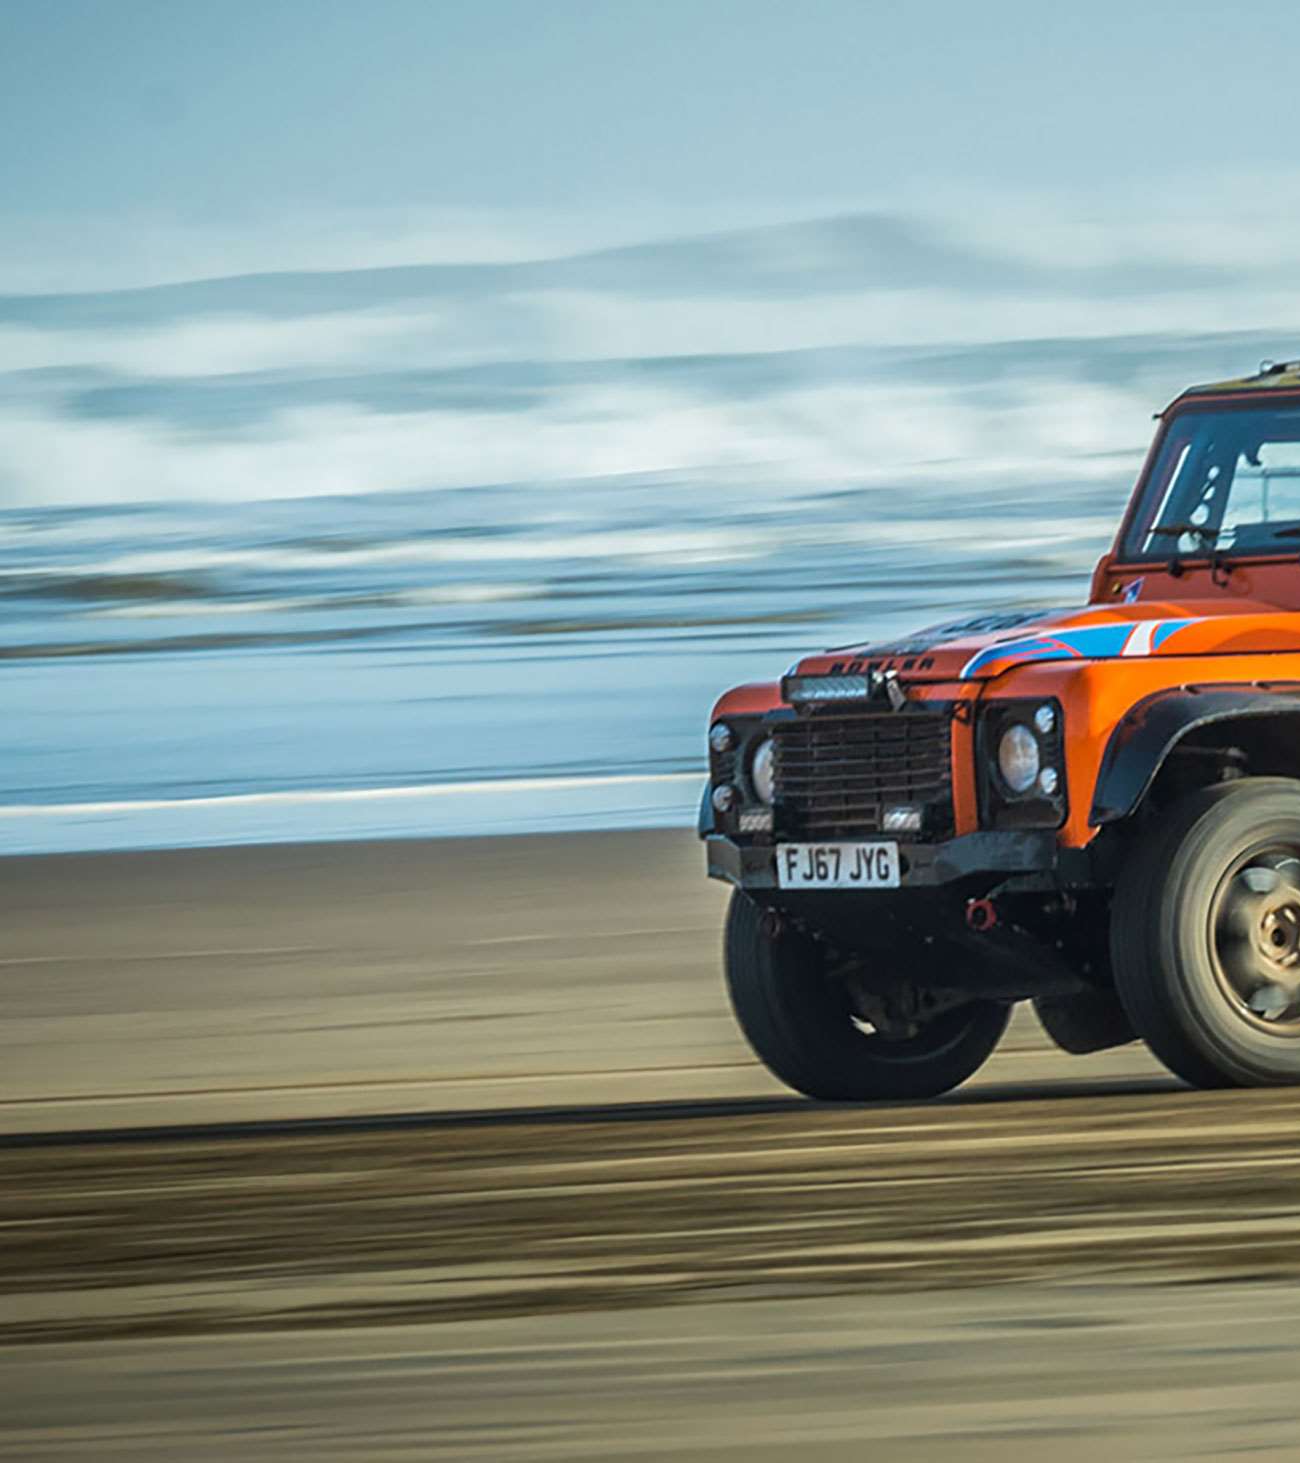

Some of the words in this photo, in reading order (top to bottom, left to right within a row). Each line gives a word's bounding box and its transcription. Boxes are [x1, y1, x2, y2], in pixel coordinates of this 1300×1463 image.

[830, 656, 935, 674] BOWLER
[785, 847, 842, 881] FJ67
[849, 847, 890, 881] JYG
